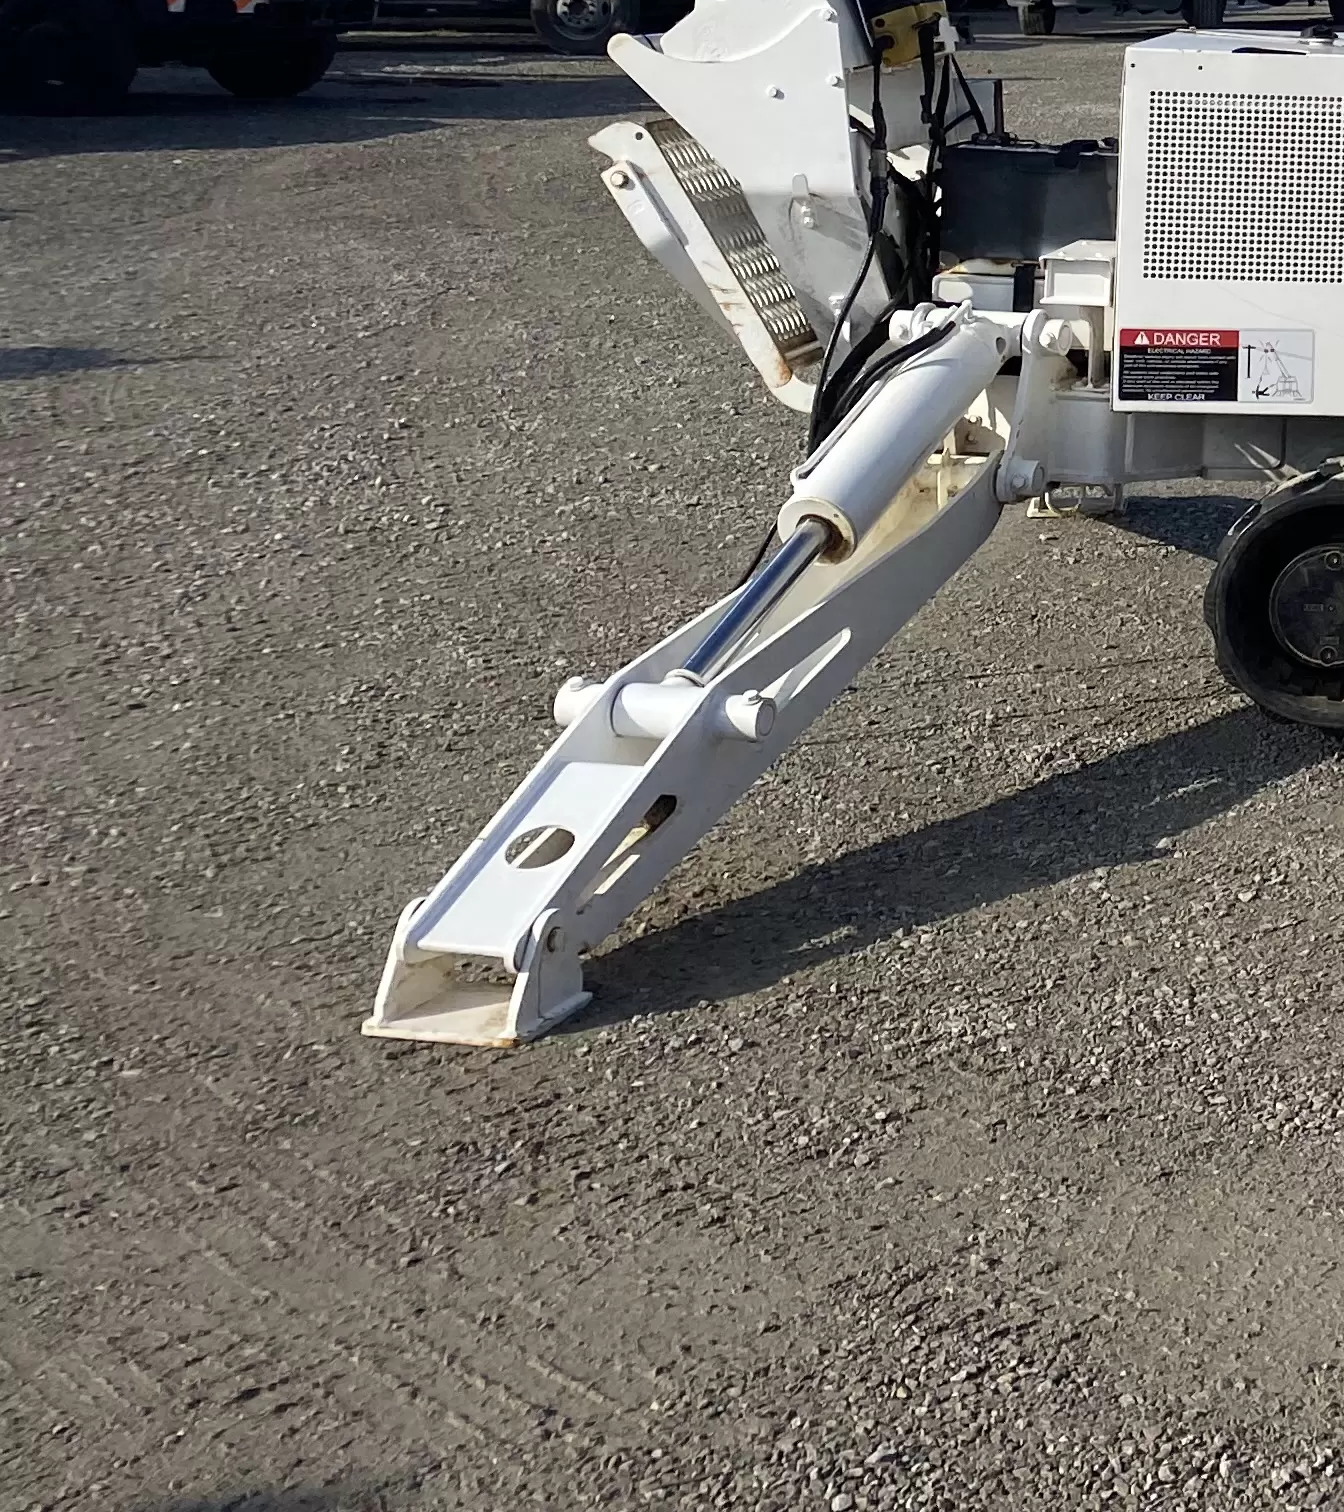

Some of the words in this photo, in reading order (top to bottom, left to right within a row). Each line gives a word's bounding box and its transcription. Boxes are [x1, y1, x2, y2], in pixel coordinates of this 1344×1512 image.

[1153, 332, 1221, 346] DANGER
[1147, 393, 1173, 401] KEEP
[1174, 393, 1206, 401] CLEAR
